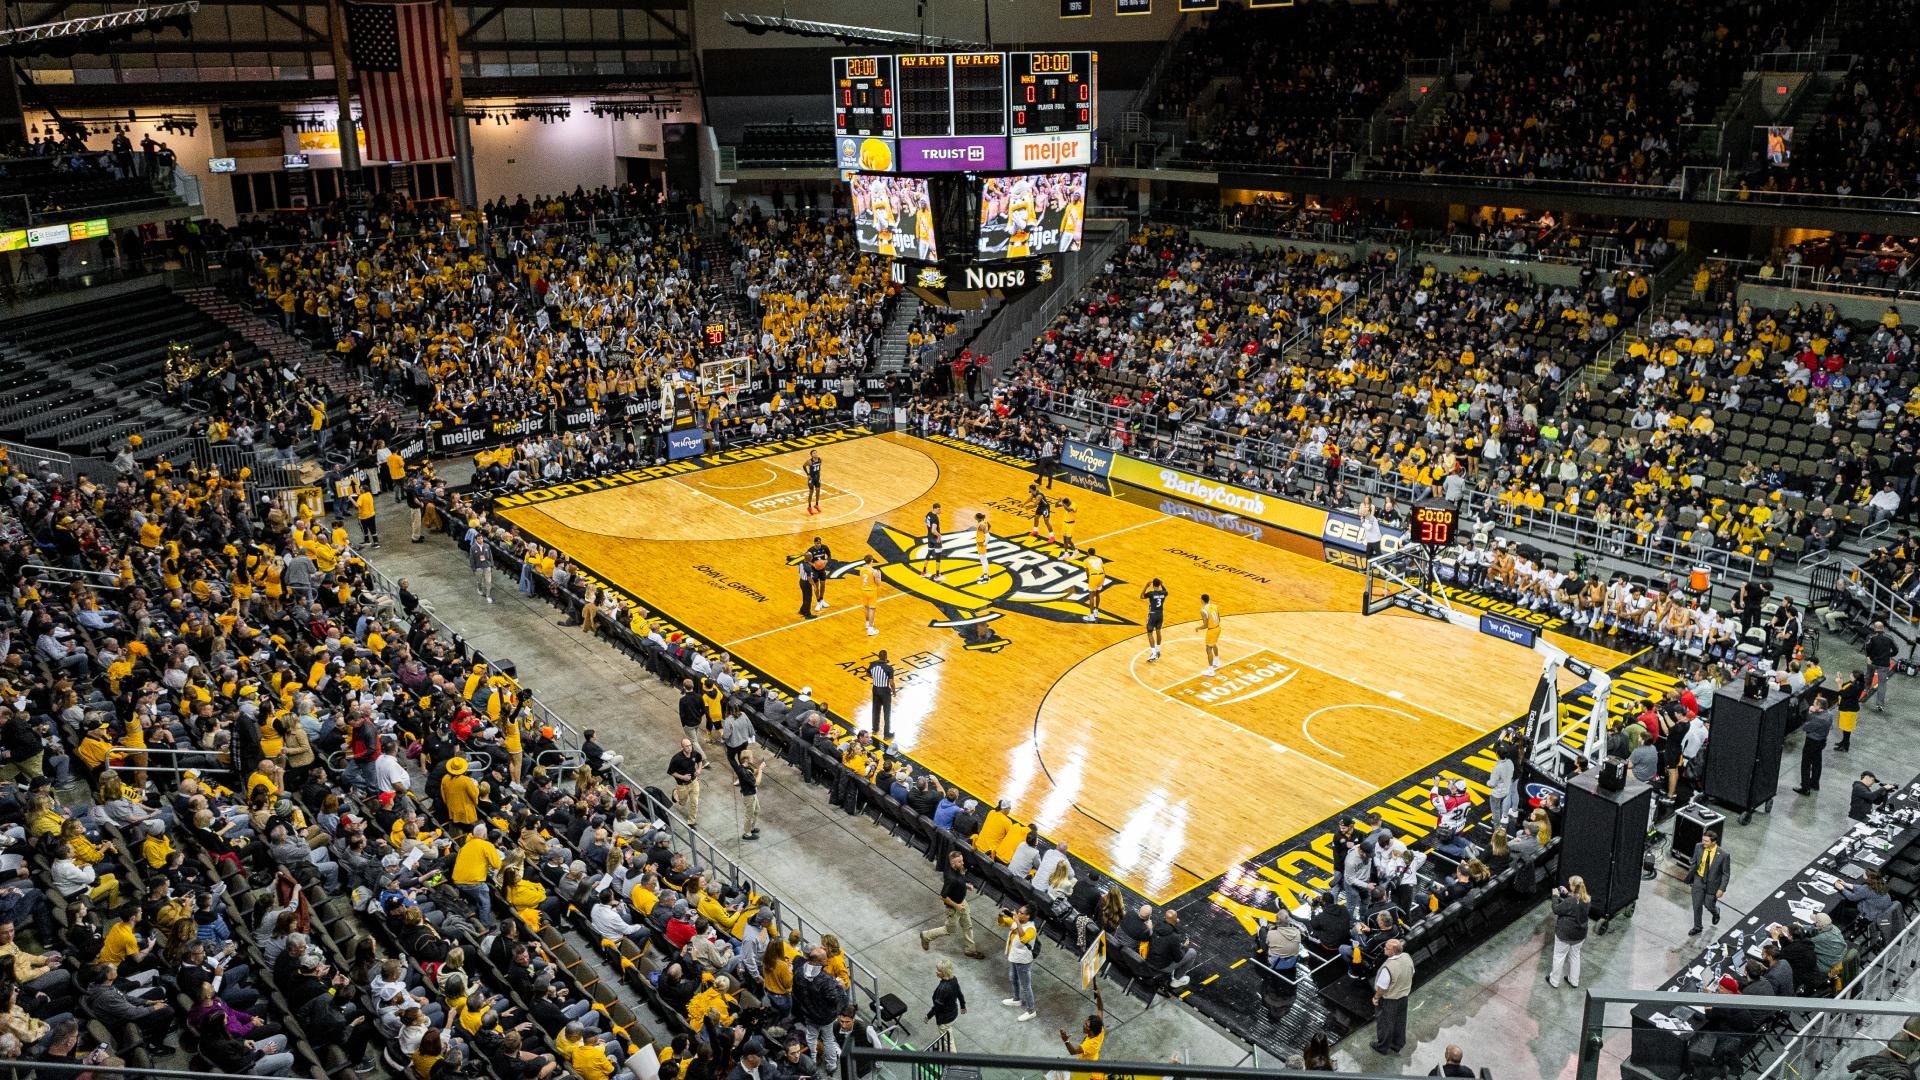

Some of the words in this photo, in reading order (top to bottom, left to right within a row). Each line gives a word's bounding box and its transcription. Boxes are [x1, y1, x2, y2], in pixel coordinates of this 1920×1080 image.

[848, 59, 876, 76] 20:00
[902, 56, 916, 66] PLY
[919, 56, 928, 65] FL
[930, 56, 945, 65] PTS
[956, 56, 970, 64] PLY
[973, 56, 982, 64] FL
[984, 55, 1000, 64] PTS
[1033, 54, 1070, 71] 20:00
[1068, 74, 1078, 82] UC
[844, 89, 852, 106] 0
[884, 89, 891, 106] 0
[1027, 86, 1035, 102] 0
[1080, 84, 1088, 100] 0
[839, 114, 845, 126] 0
[886, 114, 892, 128] 0
[1018, 112, 1024, 124] 0
[1082, 109, 1088, 122] 0
[922, 148, 966, 159] TRUIST
[1024, 137, 1078, 164] meijer
[892, 227, 916, 250] eijer
[1028, 226, 1059, 251] eijer
[965, 267, 1025, 289] Norse
[710, 332, 722, 344] 30
[566, 408, 600, 425] meije
[442, 427, 486, 446] meijer
[680, 437, 702, 449] Kroger
[400, 440, 424, 459] meijer
[495, 459, 701, 508] NORTHERN
[703, 426, 874, 466] KENTUCKY
[1078, 448, 1106, 472] Kroger
[1418, 508, 1452, 524] 20:00
[1326, 518, 1400, 552] GEIO
[1422, 522, 1447, 542] 30
[1163, 548, 1202, 560] JOHN
[1215, 564, 1270, 584] GRIFFIN
[692, 565, 724, 578] JOHN
[728, 582, 770, 602] GRIFFIN
[1156, 598, 1162, 608] 3
[1500, 624, 1523, 640] Kroger
[1195, 662, 1292, 702] HORIZON
